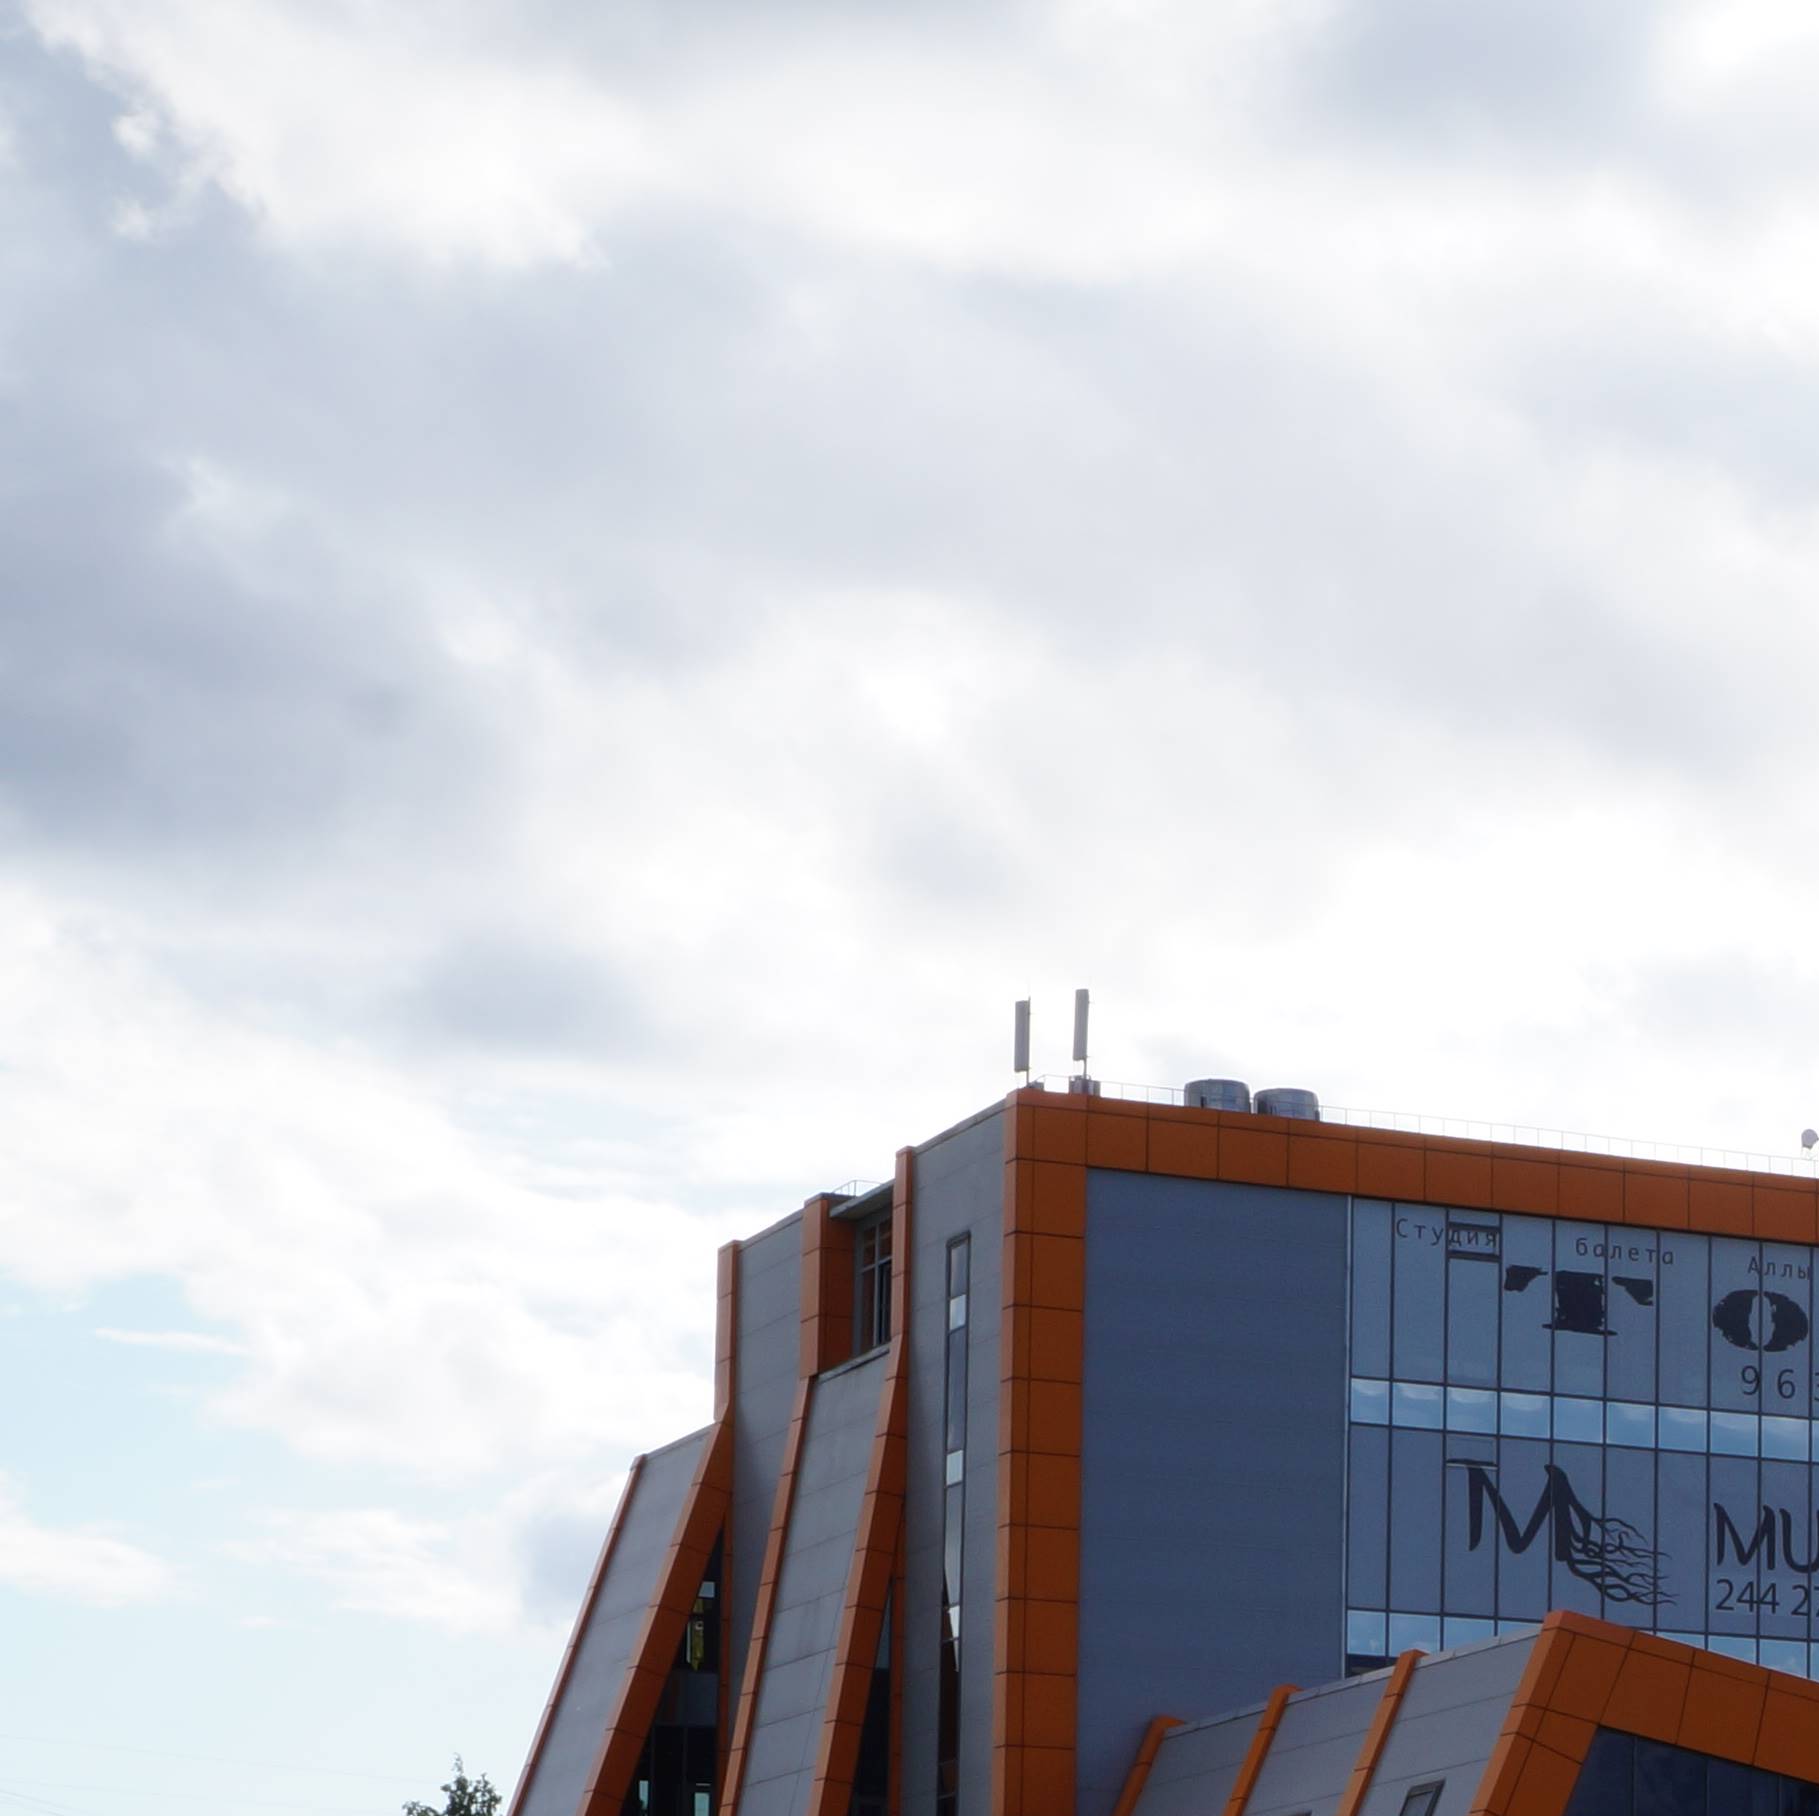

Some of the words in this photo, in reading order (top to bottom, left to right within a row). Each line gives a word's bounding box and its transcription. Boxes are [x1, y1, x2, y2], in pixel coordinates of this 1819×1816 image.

[1395, 1217, 1498, 1248] Студия
[1575, 1237, 1674, 1265] балета
[1747, 1255, 1811, 1281] Аллы
[1715, 1579, 1779, 1613] 244
